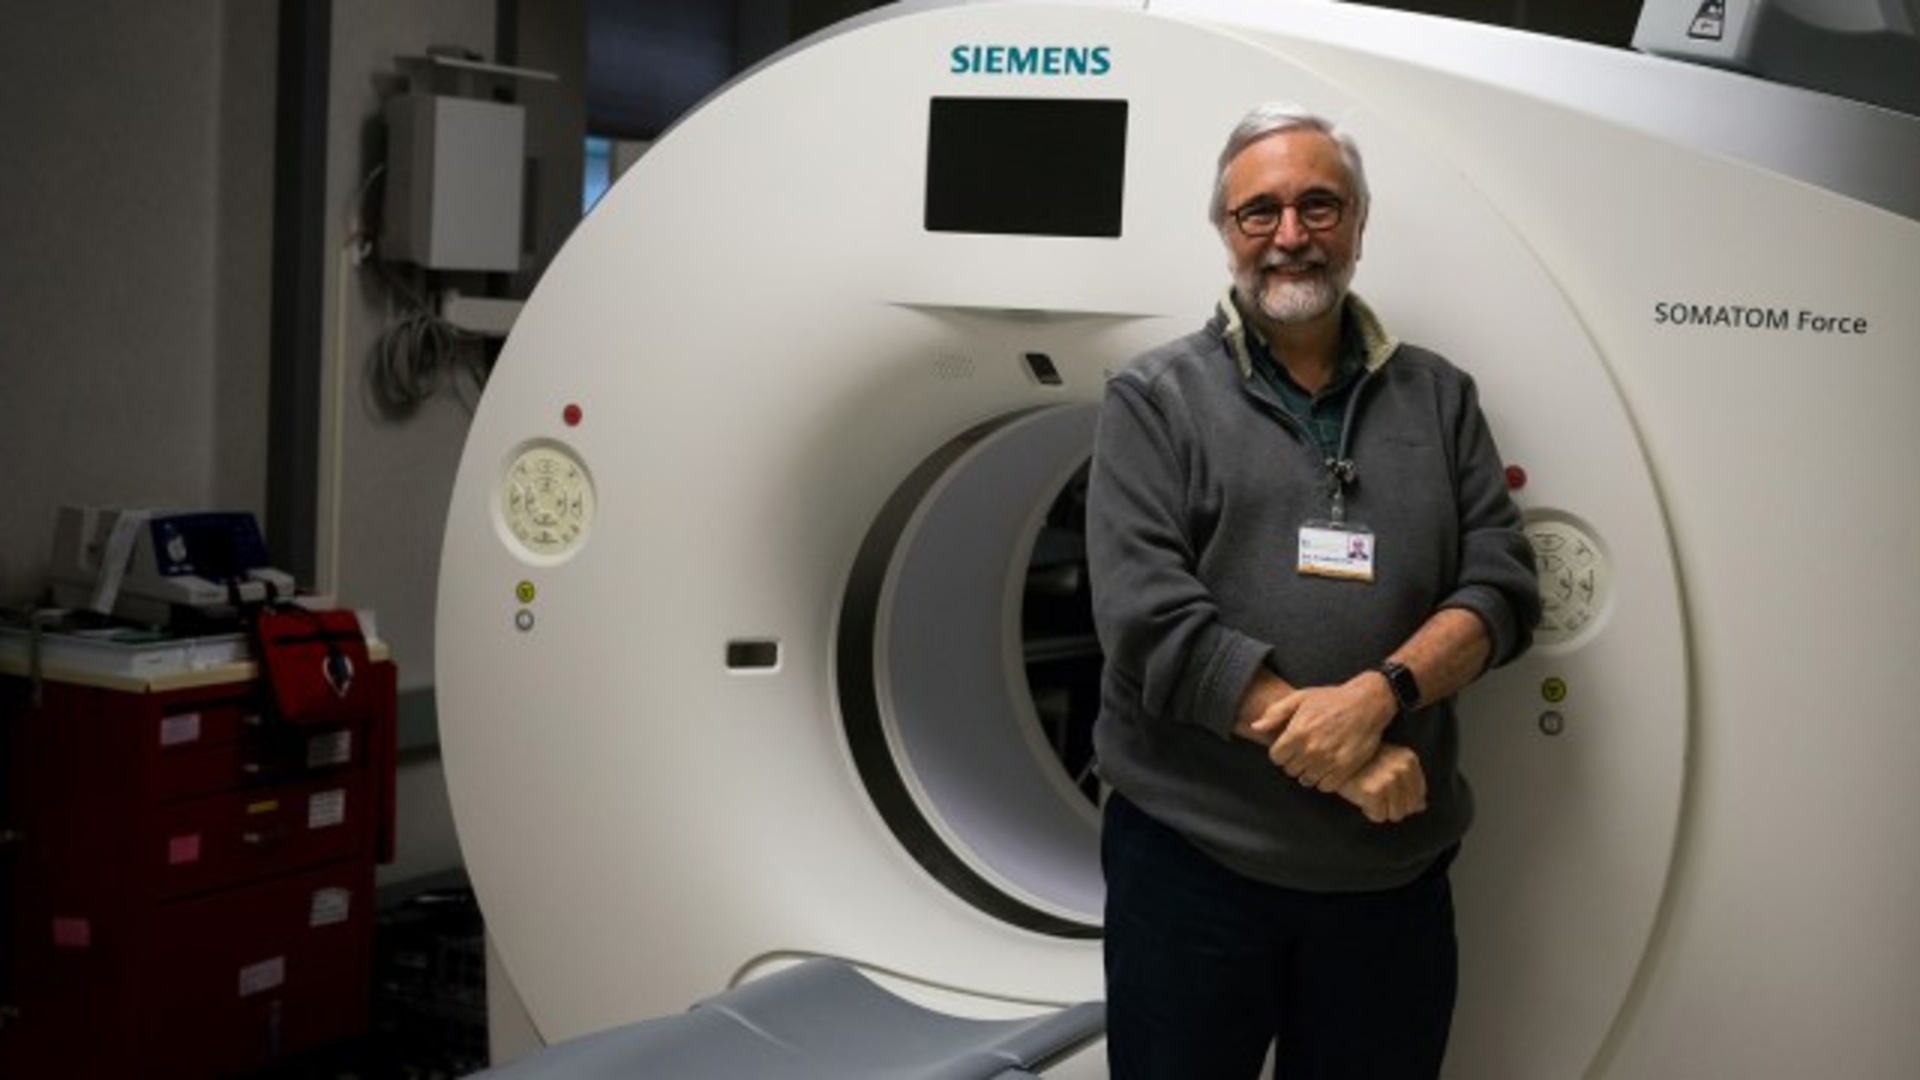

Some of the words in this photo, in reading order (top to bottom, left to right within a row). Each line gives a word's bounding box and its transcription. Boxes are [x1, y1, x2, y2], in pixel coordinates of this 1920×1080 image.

[950, 46, 1111, 75] SIEMENS
[1654, 302, 1789, 330] SOMATOM
[1797, 311, 1868, 334] Force
